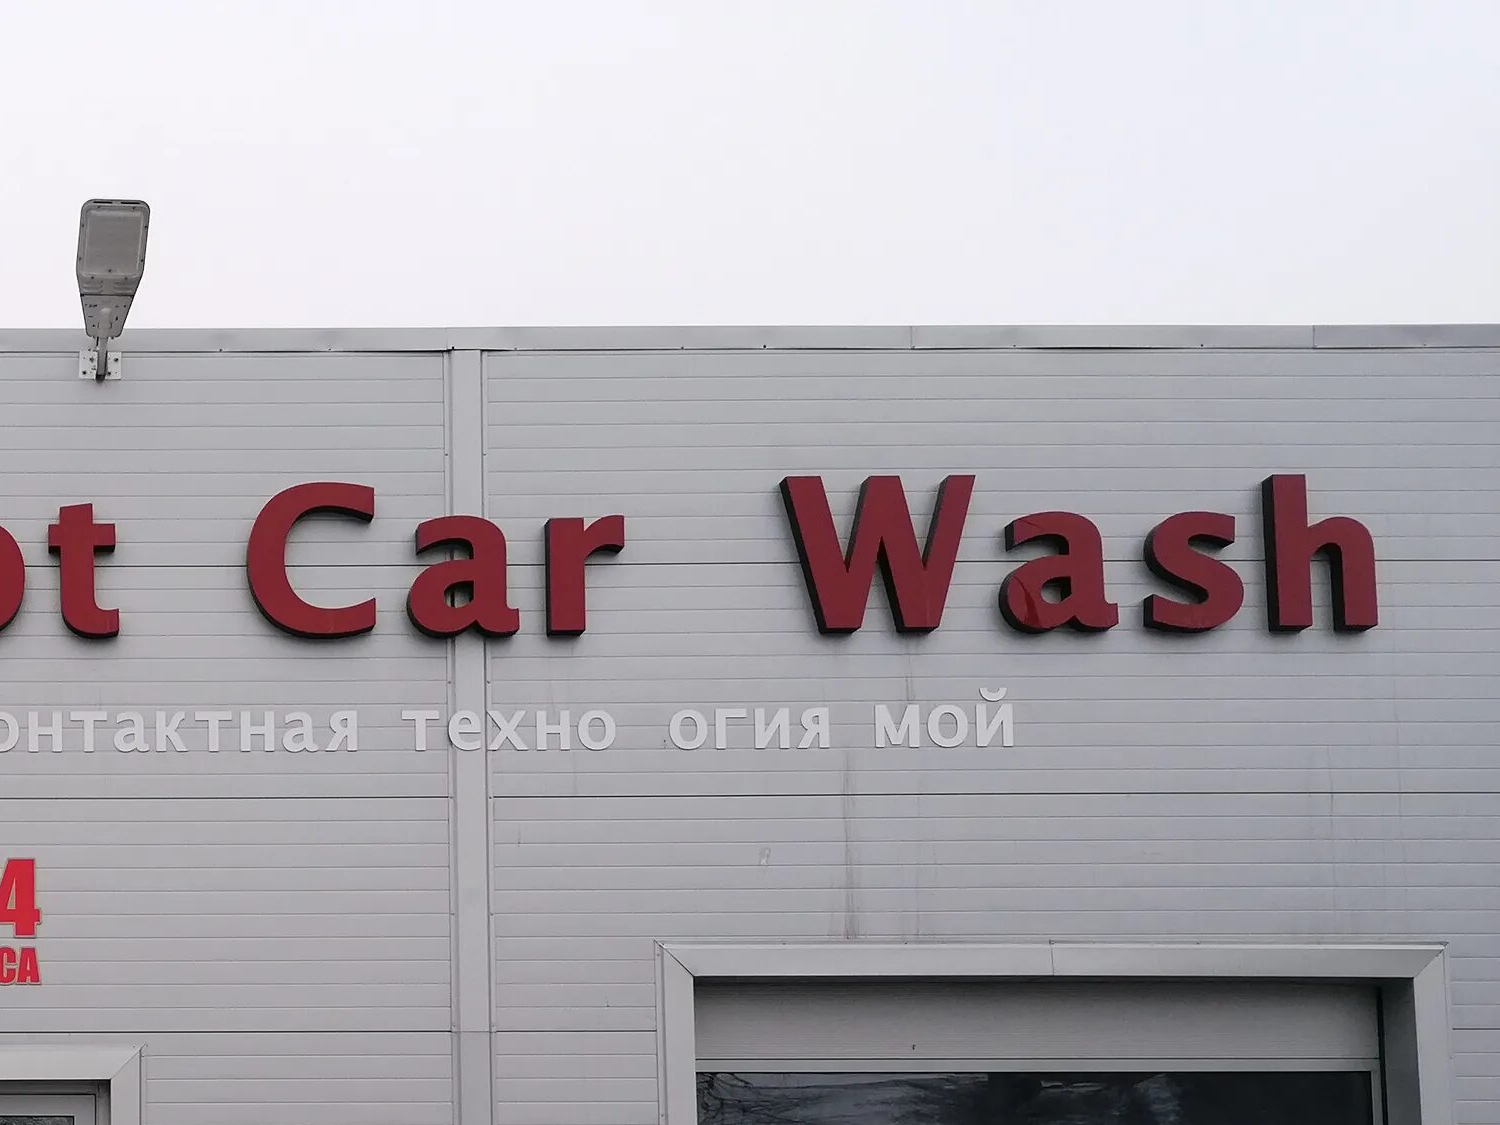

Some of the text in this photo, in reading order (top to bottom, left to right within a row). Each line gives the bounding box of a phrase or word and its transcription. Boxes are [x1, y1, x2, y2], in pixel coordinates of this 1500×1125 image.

[246, 480, 626, 637] Car
[777, 474, 1379, 634] Wash
[873, 687, 1017, 750] мой
